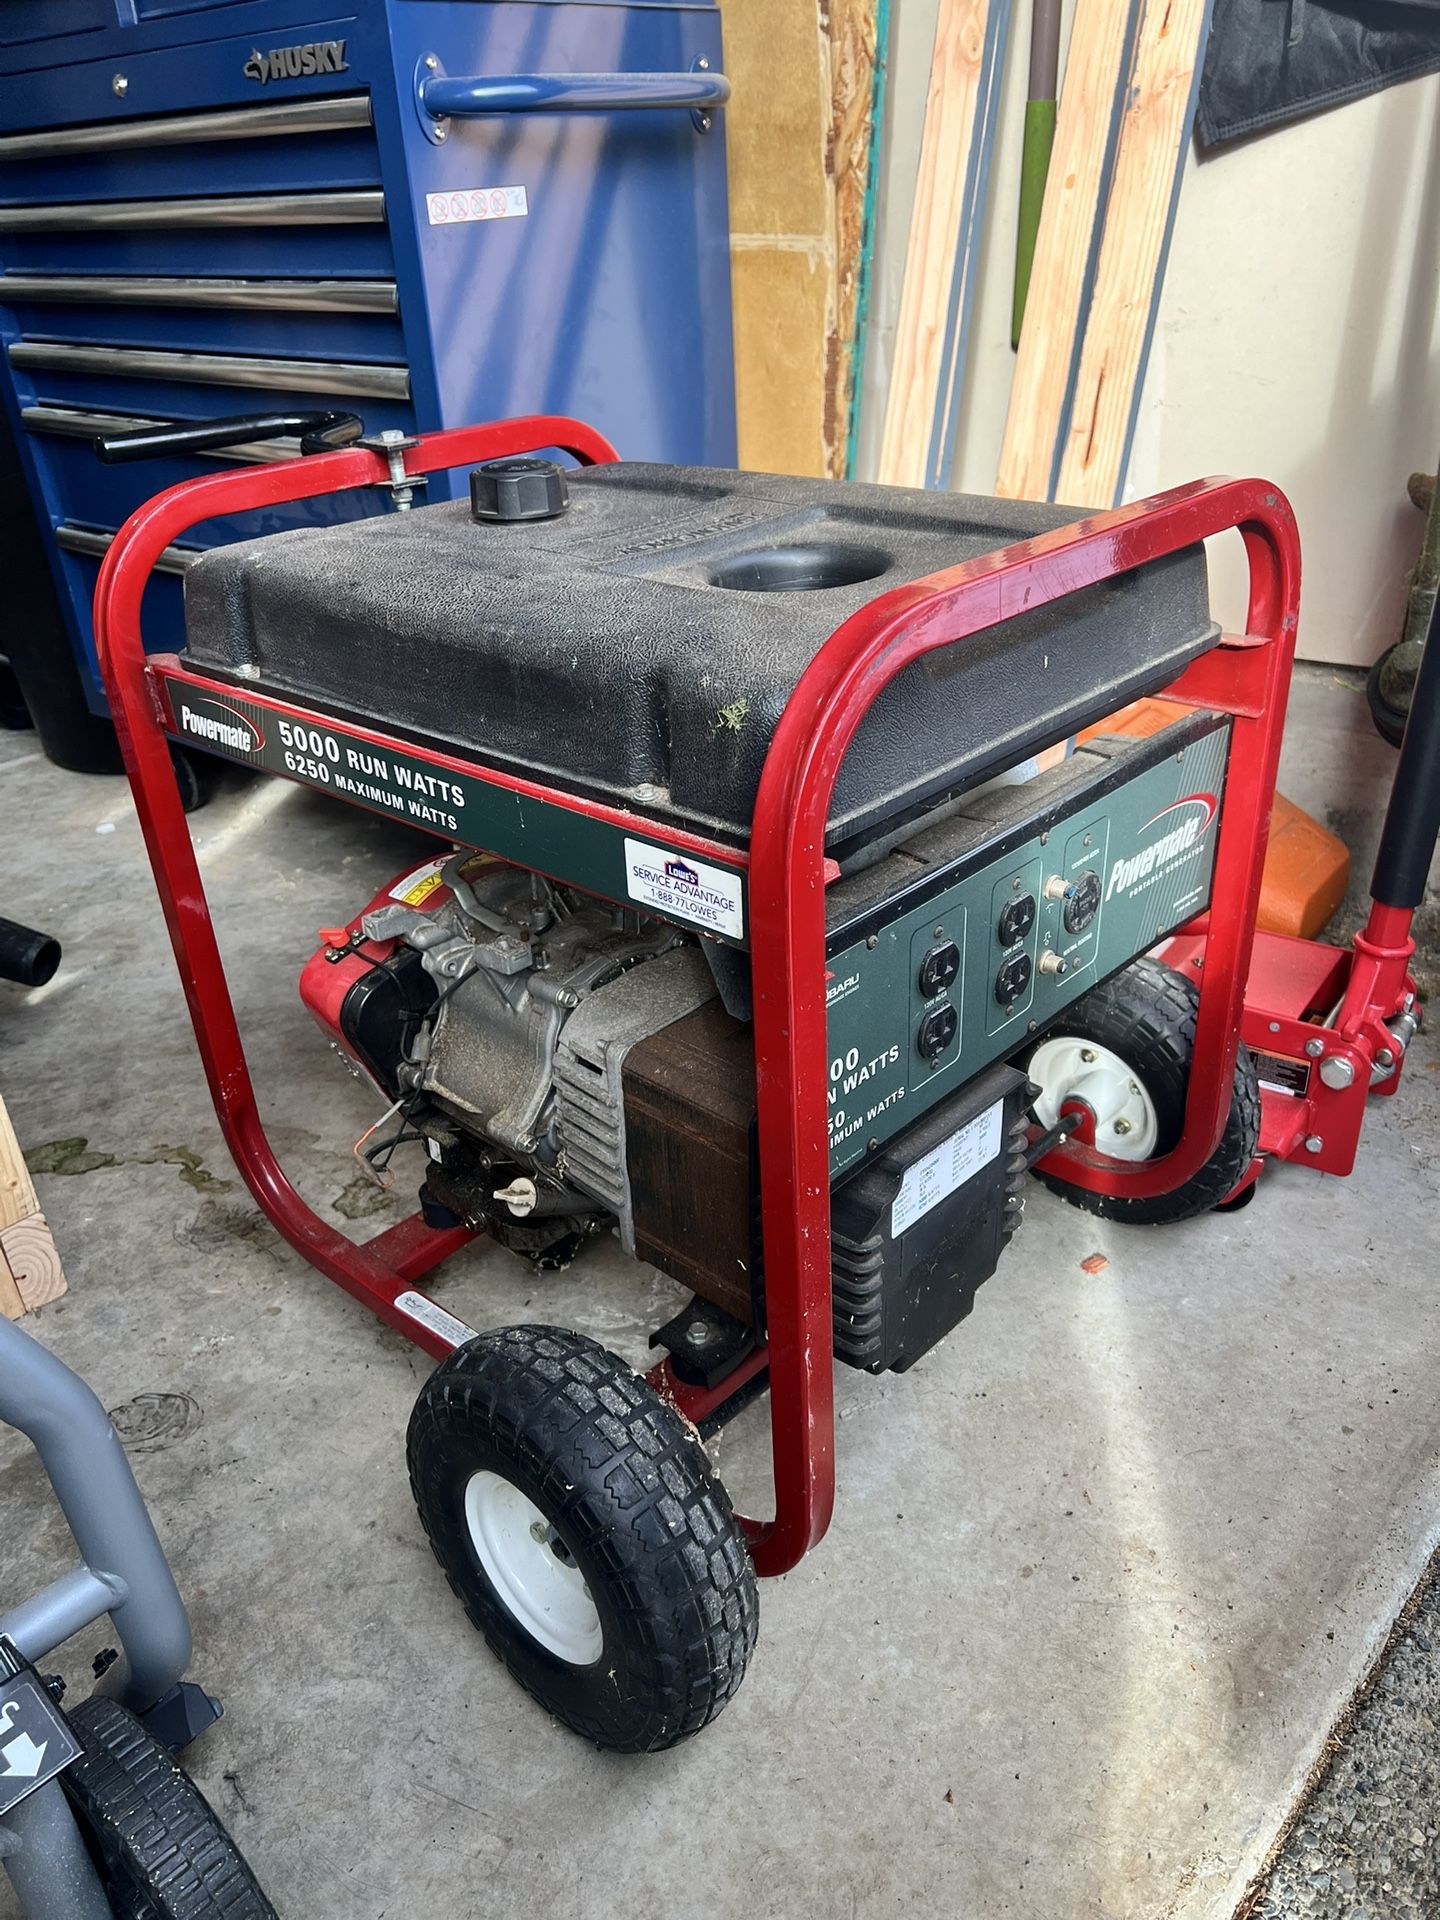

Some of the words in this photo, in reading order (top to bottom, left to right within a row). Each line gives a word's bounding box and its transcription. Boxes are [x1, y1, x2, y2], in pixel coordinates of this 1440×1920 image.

[269, 40, 346, 79] HUSKY
[181, 704, 251, 752] Powermate
[278, 720, 340, 764] 5000
[346, 748, 389, 781] RUN
[393, 764, 466, 808] WATTS
[284, 751, 330, 783] 6250
[334, 774, 404, 811] MAXIMUM
[407, 799, 458, 831] WATTS
[668, 864, 697, 883] LOWE'S
[1105, 815, 1201, 902] Powermate
[632, 865, 672, 889] SERVICE
[673, 880, 736, 913] ADVANTAGE
[830, 1047, 860, 1083] 00
[843, 1044, 899, 1096] WATTS
[830, 1116, 863, 1149] IMUM
[866, 1086, 905, 1122] WATTS
